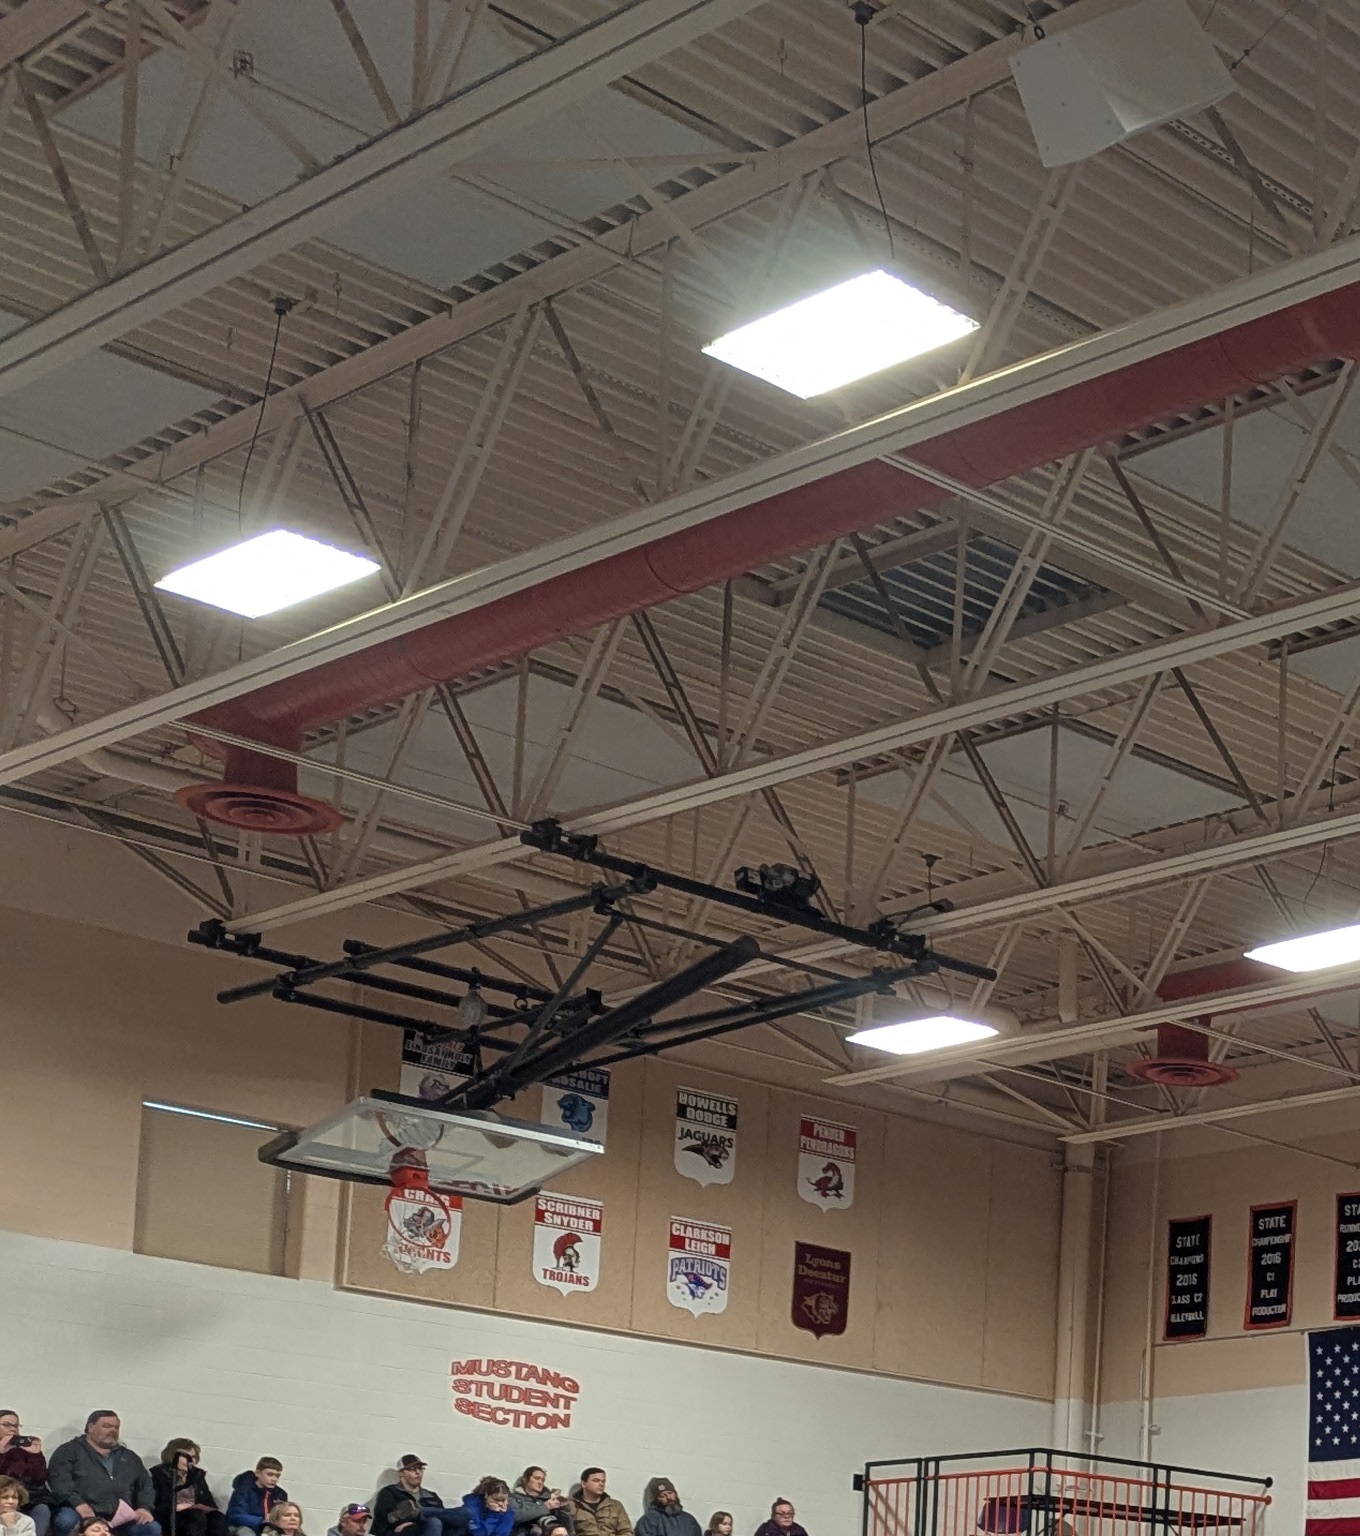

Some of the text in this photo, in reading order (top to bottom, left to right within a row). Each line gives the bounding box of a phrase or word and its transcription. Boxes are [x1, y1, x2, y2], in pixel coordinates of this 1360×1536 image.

[679, 1092, 737, 1116] HOWELLS
[686, 1107, 729, 1127] DODGE
[678, 1127, 734, 1149] JAGUARS
[538, 1198, 601, 1220] SCRIBNER
[543, 1212, 594, 1231] SNYDER
[1258, 1215, 1287, 1231] STATE
[672, 1223, 730, 1246] CLARKSON
[684, 1238, 716, 1256] LEIGH
[670, 1256, 728, 1291] PATRIOTS
[805, 1254, 842, 1271] Lyons
[541, 1267, 590, 1287] TROJANS
[799, 1264, 847, 1284] Decatur
[451, 1358, 580, 1394] MUSTANG
[451, 1378, 578, 1410] STUDENT
[454, 1397, 572, 1430] SECTION
